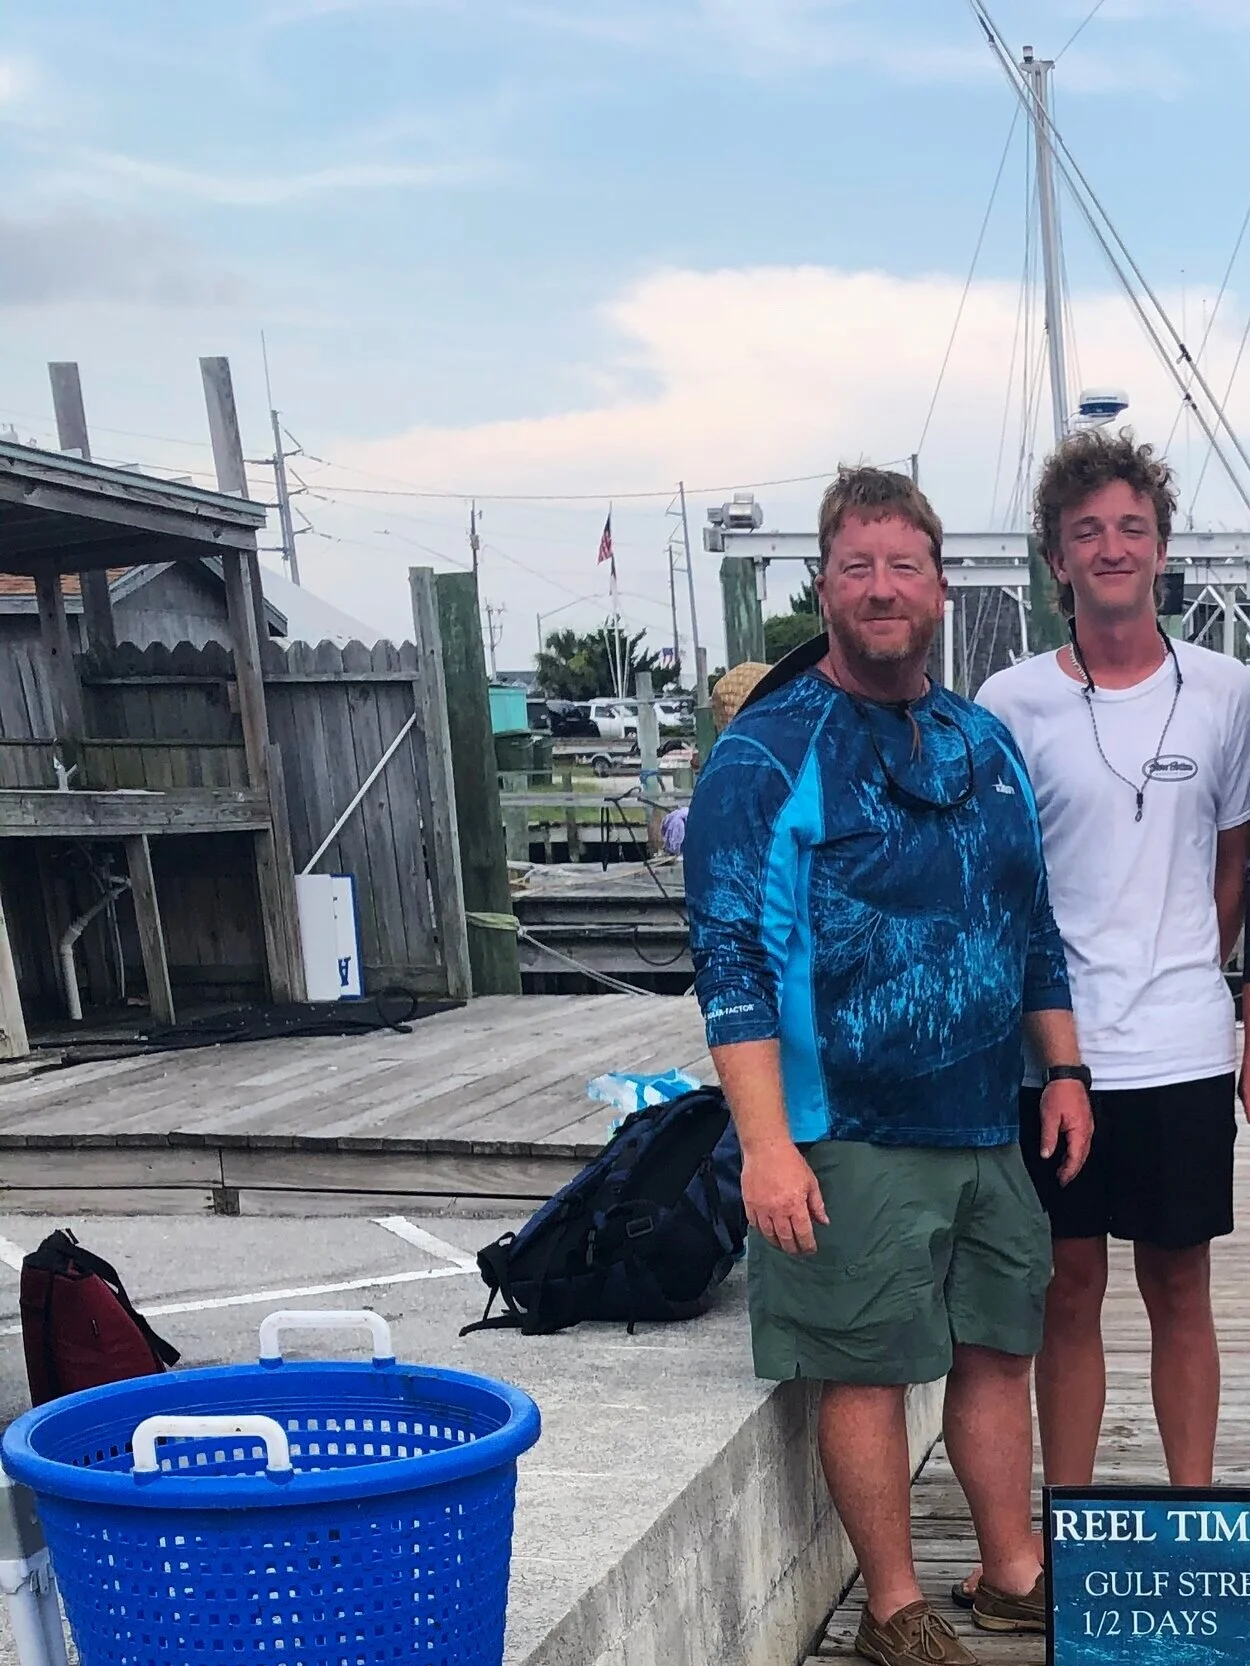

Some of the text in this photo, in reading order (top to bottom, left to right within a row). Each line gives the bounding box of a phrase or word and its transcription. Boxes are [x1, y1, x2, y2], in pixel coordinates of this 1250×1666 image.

[1052, 1509, 1157, 1542] REEL
[1085, 1571, 1170, 1597] GULF
[1083, 1610, 1122, 1638] 1/2
[1131, 1610, 1218, 1636] DAYS
